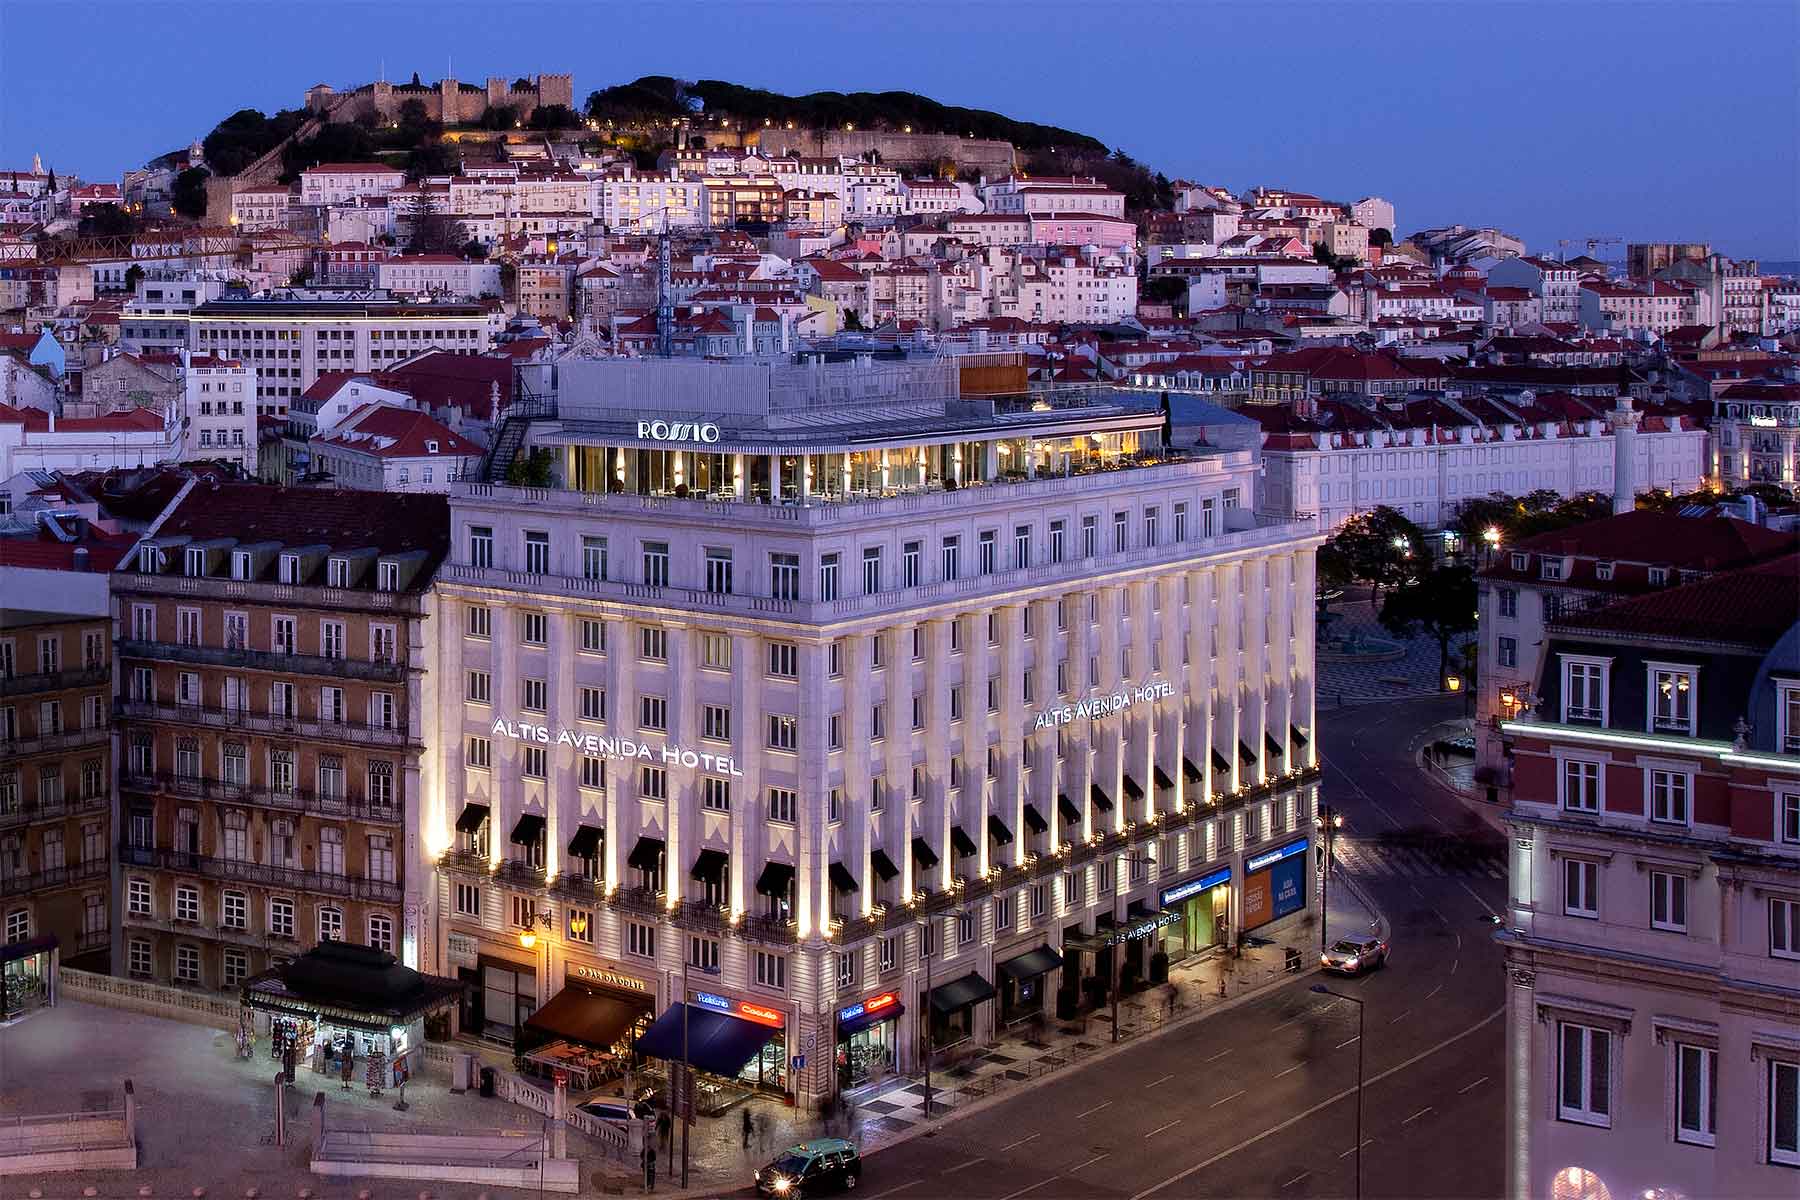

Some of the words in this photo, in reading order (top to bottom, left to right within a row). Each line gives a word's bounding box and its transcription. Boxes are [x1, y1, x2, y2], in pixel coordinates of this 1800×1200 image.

[637, 420, 720, 443] ROSSIO
[1034, 707, 1072, 730] ALTIS
[1075, 693, 1131, 719] AVENIDA
[1134, 681, 1176, 704] HOTEL
[491, 718, 550, 744] ALTIS
[556, 730, 653, 761] AVENIDA
[662, 745, 744, 776] HOTEL
[1104, 934, 1126, 945] AIS
[1128, 922, 1157, 939] AVENIDA
[1158, 913, 1181, 927] HOTEL
